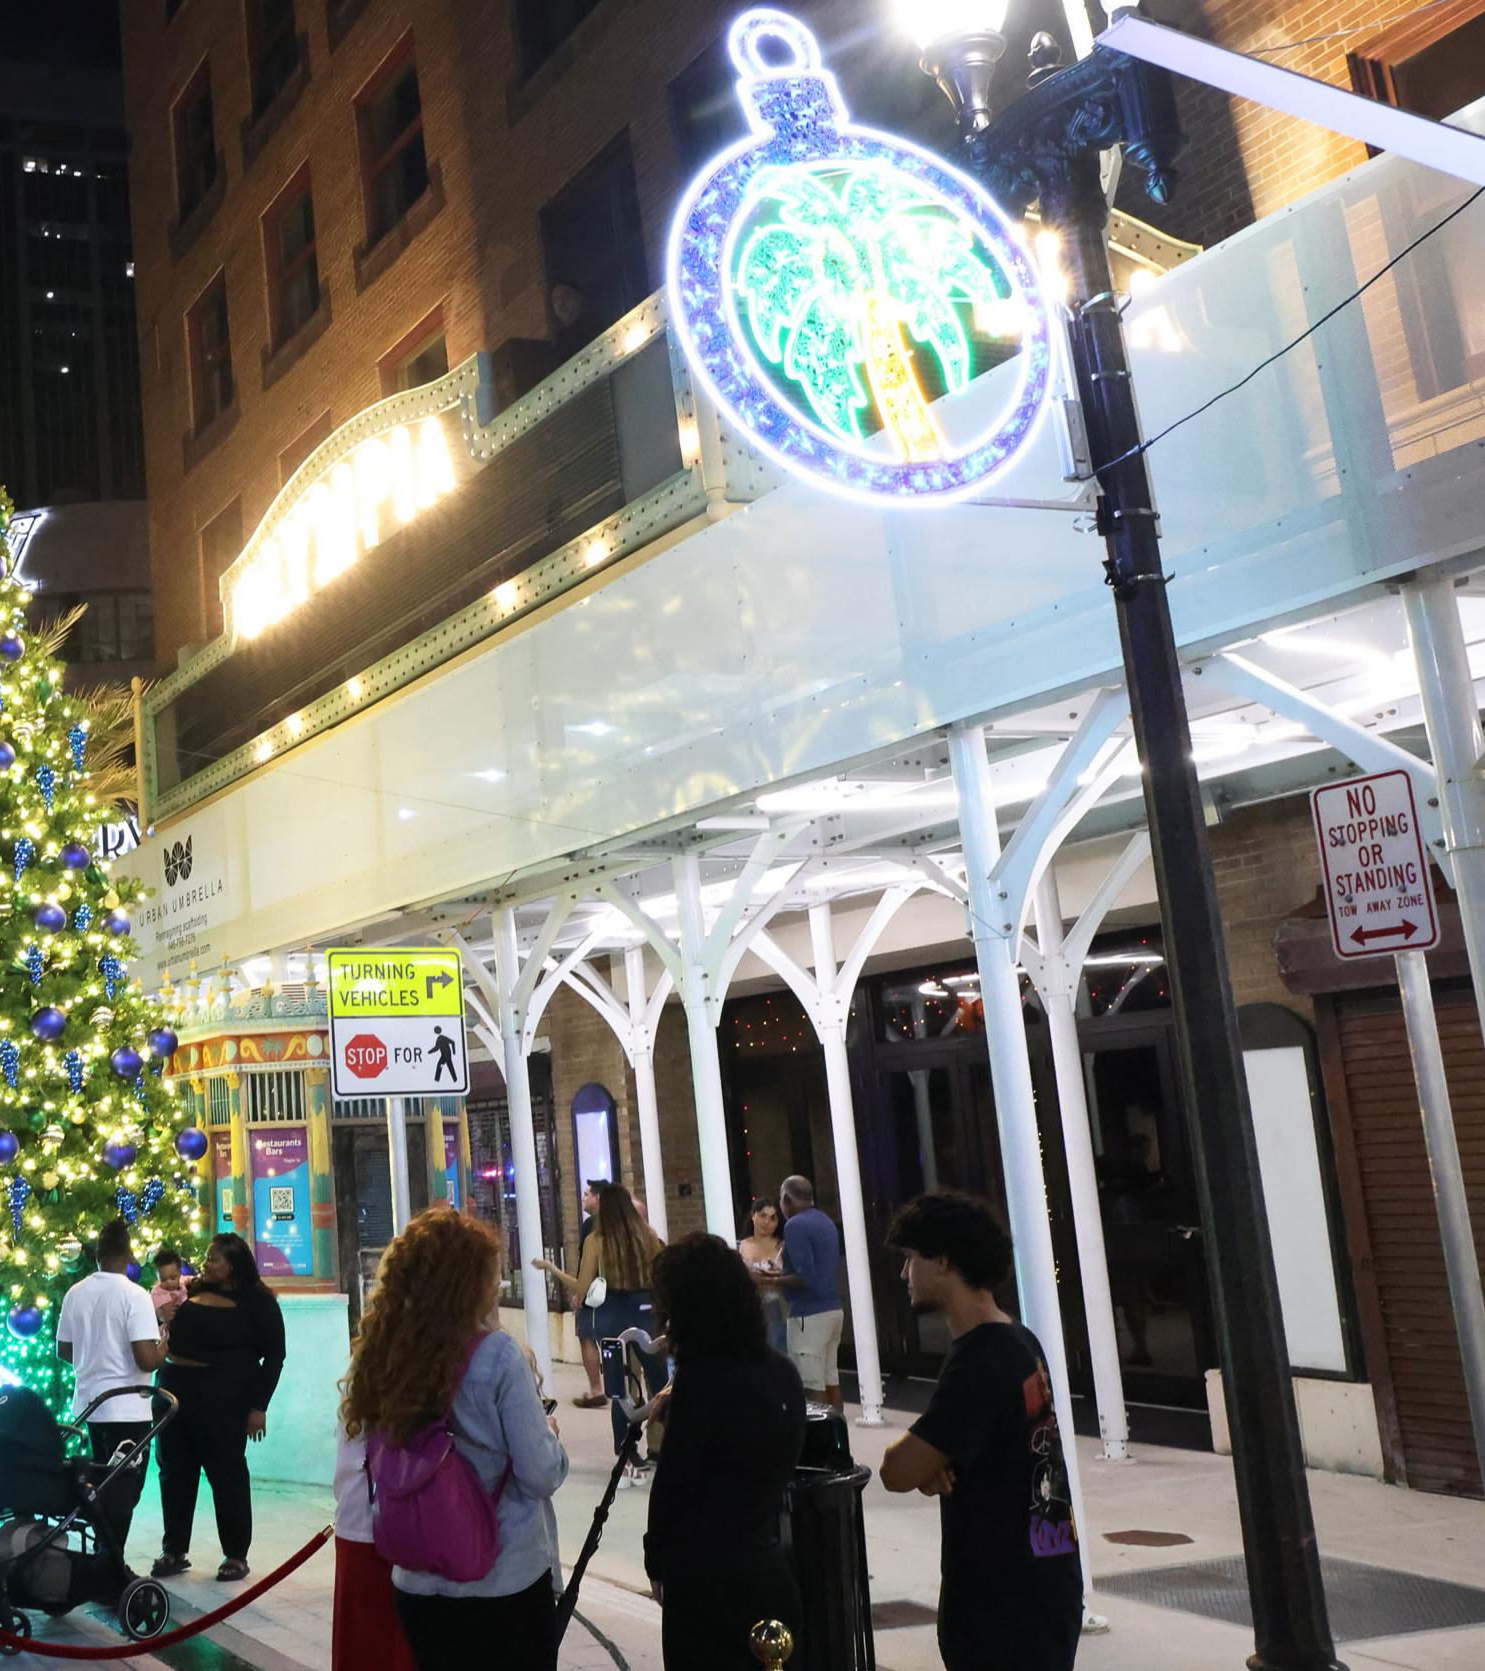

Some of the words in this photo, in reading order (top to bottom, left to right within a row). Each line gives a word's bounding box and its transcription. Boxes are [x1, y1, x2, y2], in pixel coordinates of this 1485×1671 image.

[1346, 784, 1376, 819] NO
[1328, 813, 1409, 848] STOPPING
[1358, 843, 1384, 867] OR
[1336, 862, 1417, 897] STANDING
[139, 903, 168, 927] URBAN
[172, 878, 223, 913] UMBRELLA
[1338, 905, 1358, 917] TOW
[1366, 899, 1392, 914] AWAY
[1397, 894, 1424, 909] ZONE
[340, 964, 415, 980] TURNING
[339, 990, 420, 1006] VEHICLES
[347, 1048, 386, 1065] STOP
[394, 1047, 422, 1063] FOR
[266, 1148, 283, 1156] Bars
